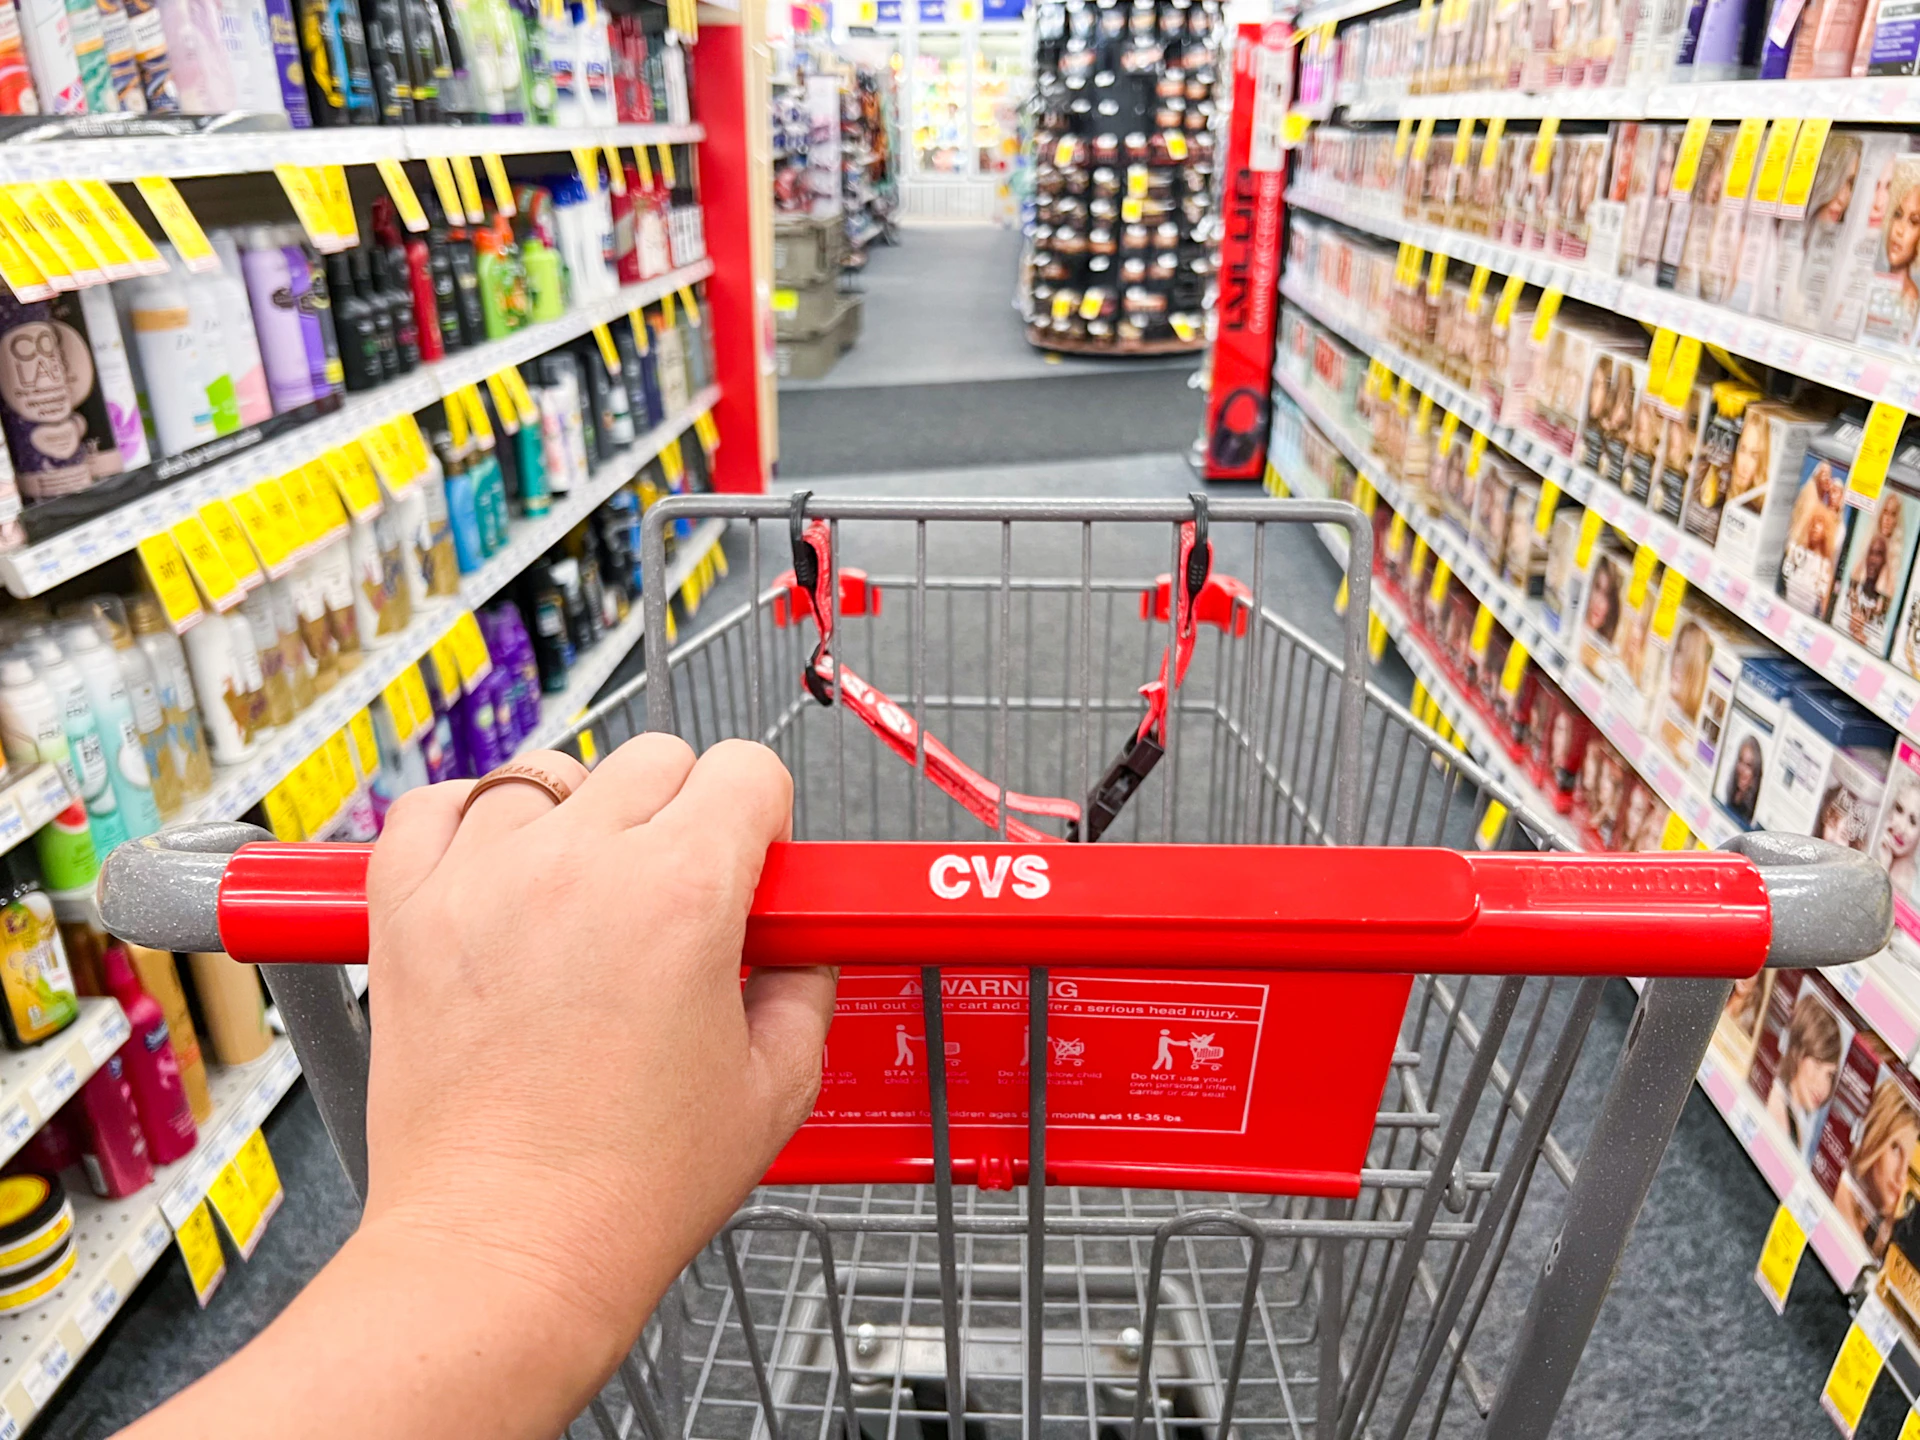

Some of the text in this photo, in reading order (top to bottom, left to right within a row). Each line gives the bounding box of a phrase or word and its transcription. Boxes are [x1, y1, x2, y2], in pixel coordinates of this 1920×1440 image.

[928, 853, 1052, 900] CVS
[835, 1002, 851, 1010] an
[855, 1001, 877, 1010] fall
[882, 1002, 907, 1010] out
[958, 1001, 988, 1010] cart
[992, 1001, 1020, 1010] and
[1073, 1004, 1083, 1012] a
[1086, 1004, 1145, 1015] serious
[1149, 1006, 1187, 1016] head
[1191, 1008, 1239, 1019] injury.
[883, 1069, 915, 1077] STAY
[1130, 1072, 1148, 1081] Do
[1150, 1073, 1177, 1081] NOT
[1202, 1076, 1228, 1084] your
[1155, 1082, 1203, 1090] personal
[1205, 1083, 1238, 1092] infant
[809, 1110, 835, 1118] NLY
[838, 1110, 861, 1118] use
[1051, 1112, 1096, 1120] months
[1099, 1113, 1123, 1121] and
[1127, 1113, 1160, 1122] 15-35
